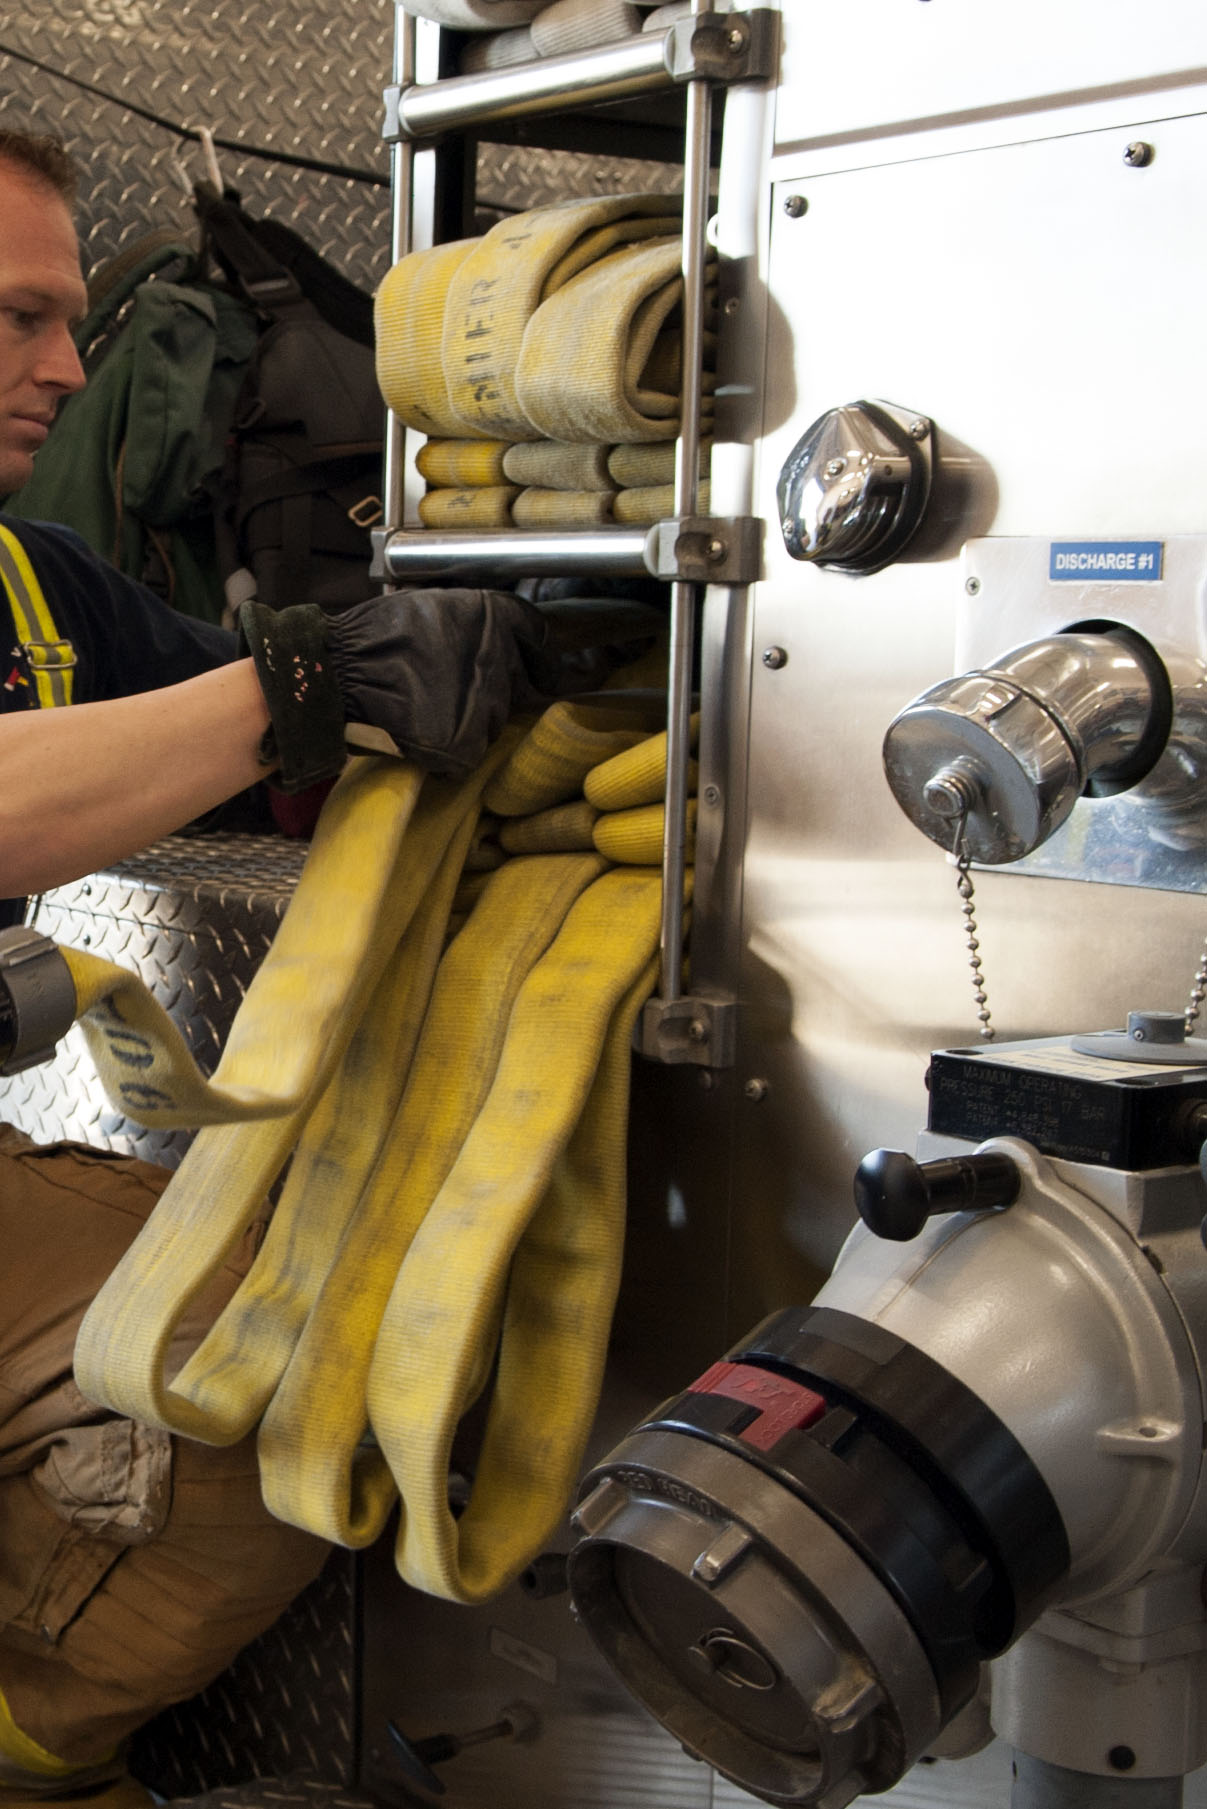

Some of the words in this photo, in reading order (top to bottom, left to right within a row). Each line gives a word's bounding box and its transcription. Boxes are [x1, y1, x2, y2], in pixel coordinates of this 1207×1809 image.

[1055, 553, 1137, 570] DISCHARGE
[1138, 553, 1154, 570] #1
[939, 1077, 994, 1099] PRESSURE
[962, 1064, 1012, 1086] MAXIMUM
[1018, 1074, 1083, 1100] OPERATING
